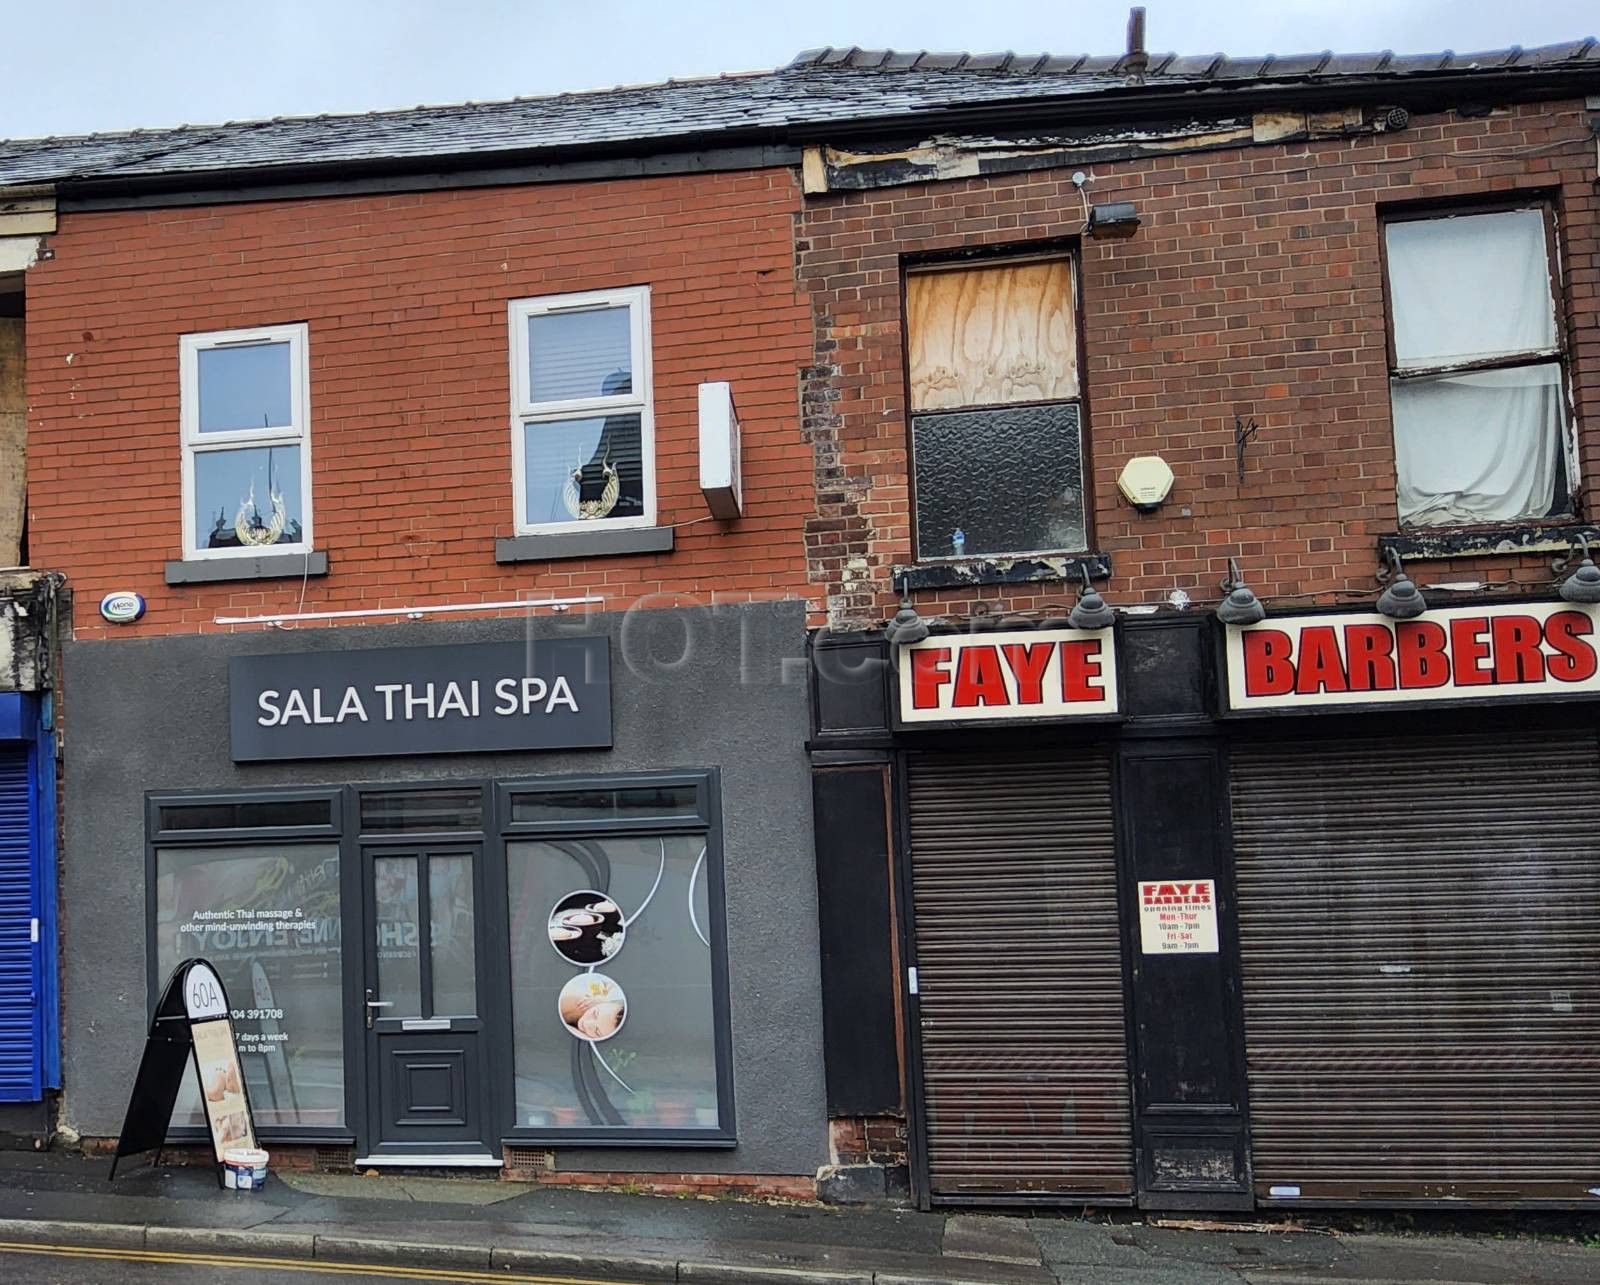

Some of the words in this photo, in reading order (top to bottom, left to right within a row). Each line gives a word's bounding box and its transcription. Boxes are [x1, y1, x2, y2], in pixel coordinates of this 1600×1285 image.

[1241, 610, 1598, 698] BARBERS
[910, 639, 1106, 710] FAYE
[257, 687, 369, 726] SALA
[374, 680, 480, 720] THAI
[494, 676, 580, 715] SPA
[1143, 884, 1211, 896] FAYE
[1144, 896, 1211, 905] BARBERS
[192, 910, 235, 921] Authentic
[236, 909, 255, 920] Thai
[256, 909, 293, 920] massage
[295, 908, 303, 918] &
[1144, 905, 1183, 913] opening
[180, 922, 204, 933] other
[205, 920, 274, 932] mind-unwinding
[275, 919, 317, 932] therapies
[192, 982, 220, 1010] 60A
[230, 1009, 245, 1020] 04
[246, 1009, 284, 1019] 391708
[241, 1033, 260, 1043] days
[266, 1032, 289, 1041] week
[247, 1044, 257, 1052] to
[257, 1043, 276, 1053] 8pm
